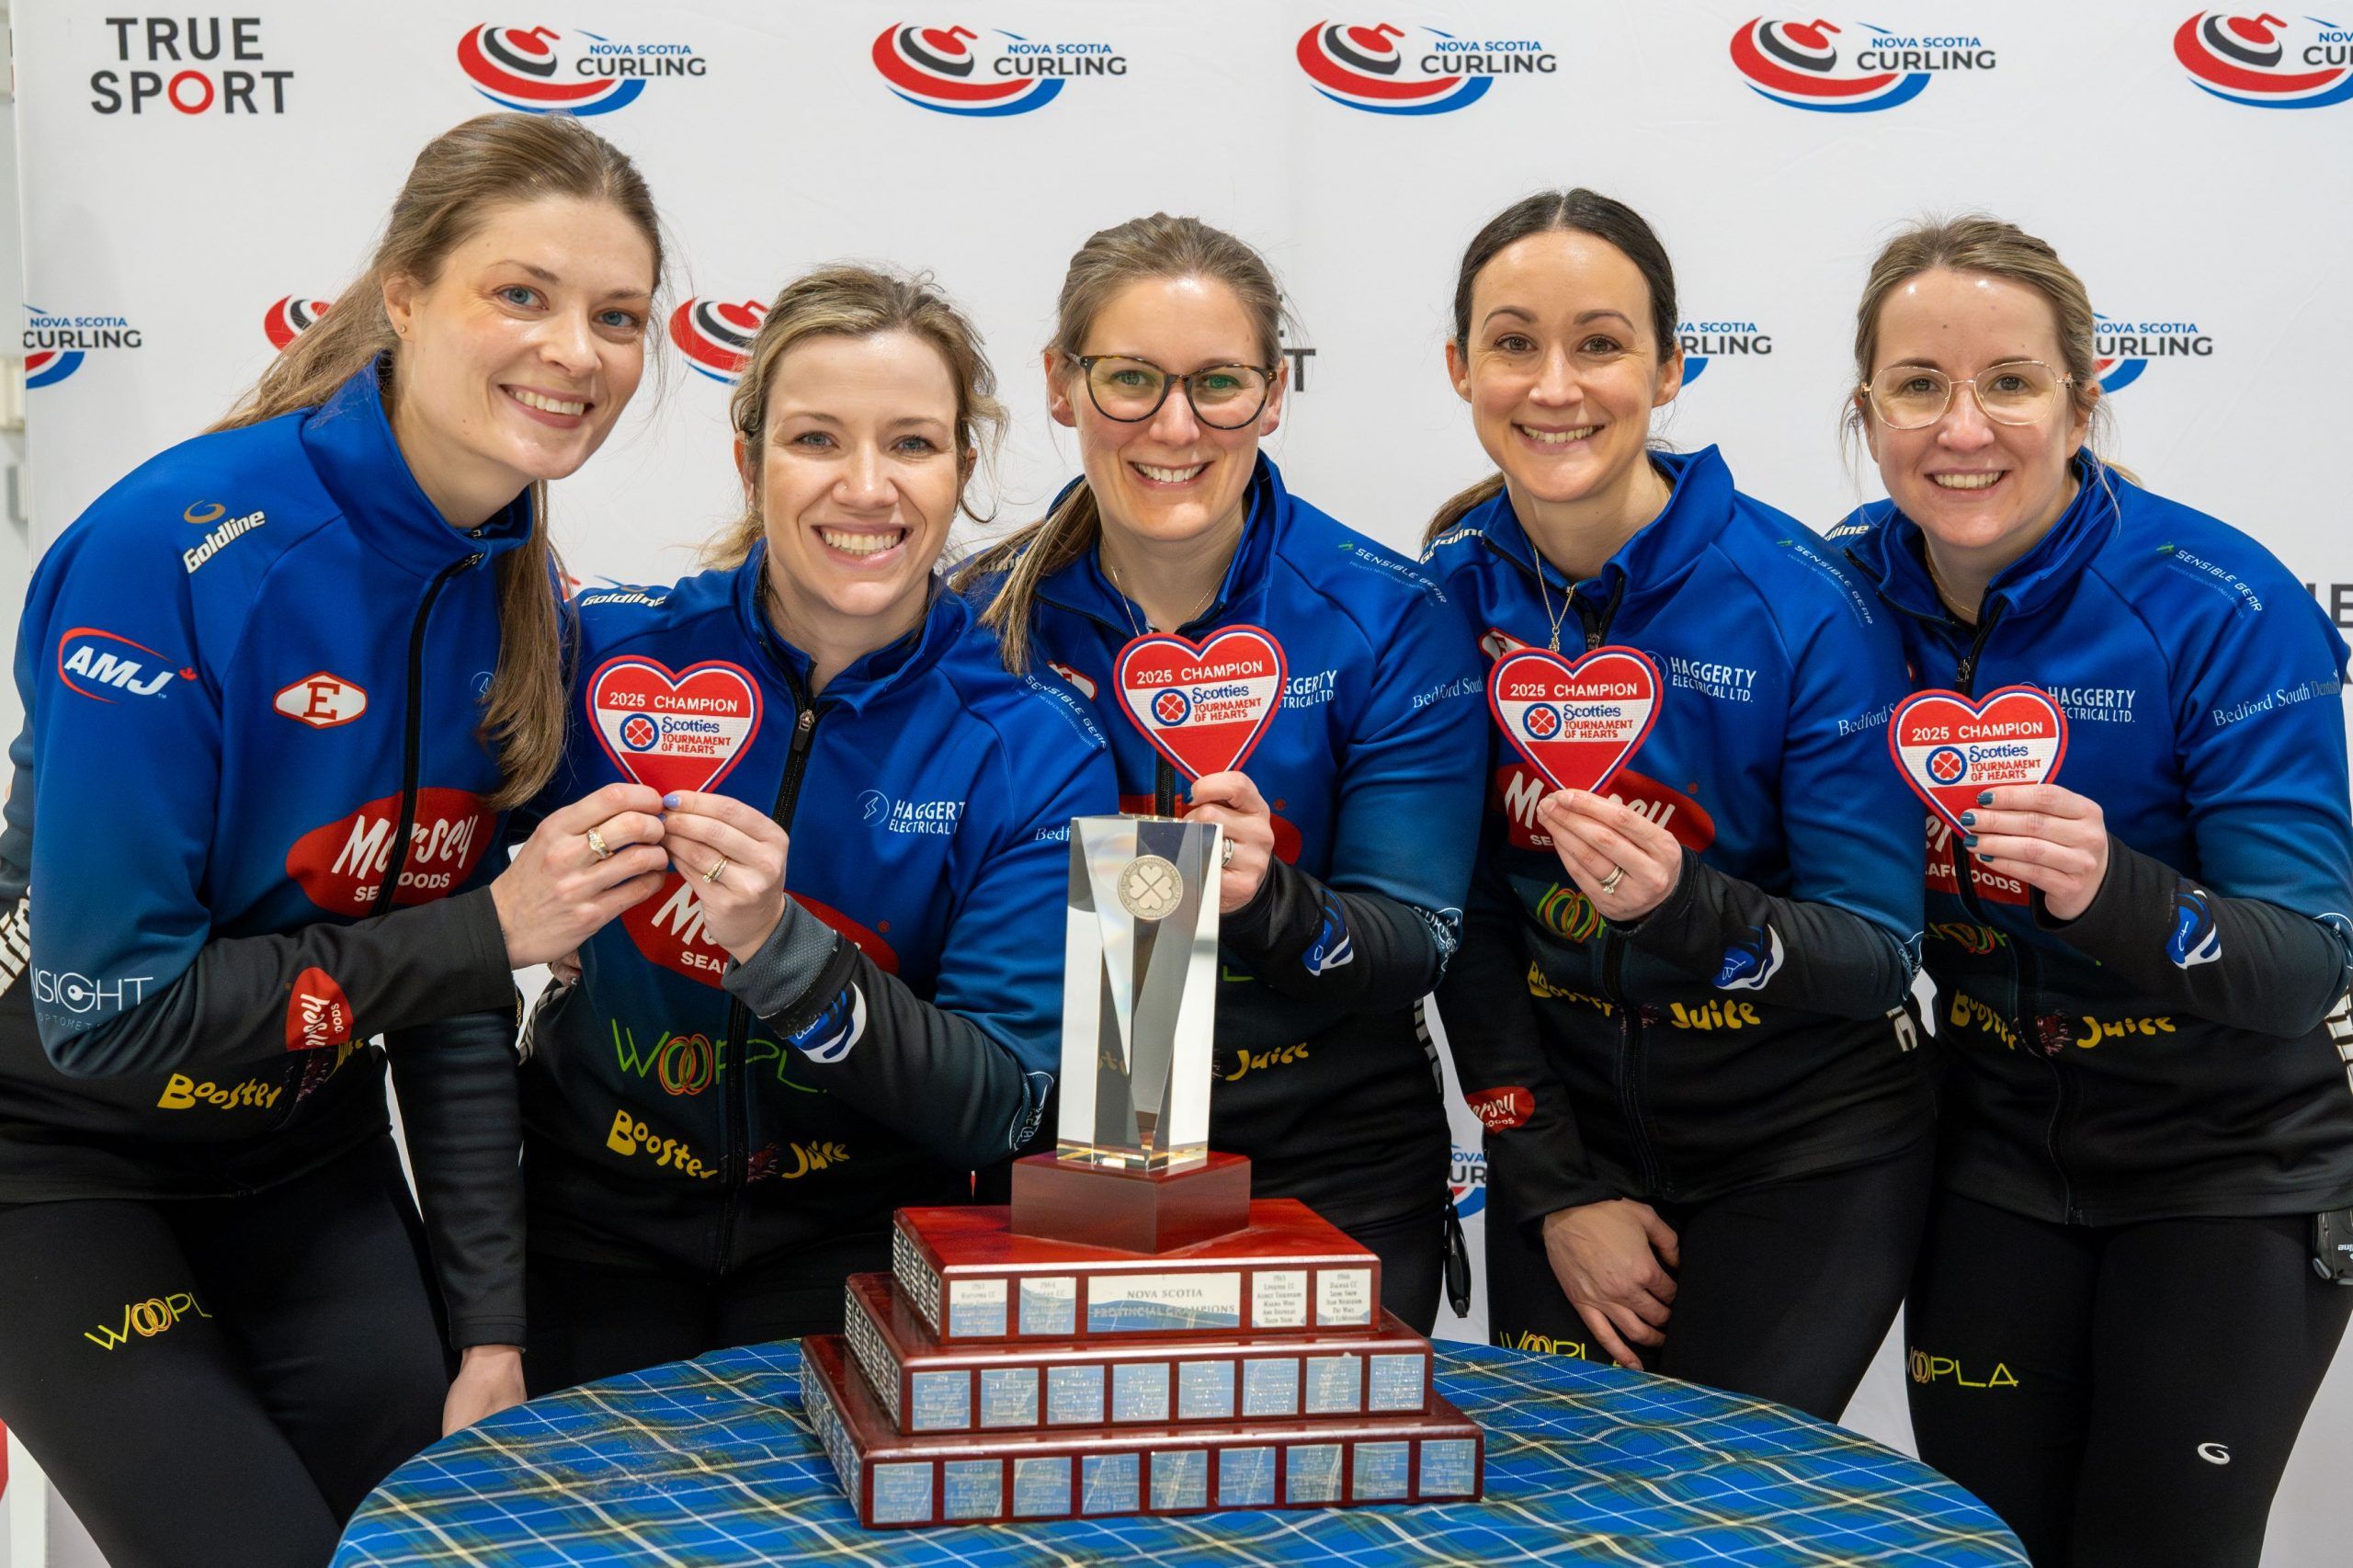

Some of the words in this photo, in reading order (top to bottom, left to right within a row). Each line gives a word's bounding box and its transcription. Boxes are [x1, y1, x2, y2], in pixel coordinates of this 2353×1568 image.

[107, 17, 264, 61] TRUE
[1436, 41, 1480, 52] NOVA
[1486, 41, 1542, 52] SCOTIA
[1872, 38, 1916, 48] NOVA
[1923, 38, 1982, 48] SCOTIA
[2319, 32, 2353, 42] NOV
[589, 44, 632, 54] NOVA
[637, 44, 692, 54] SCOTIA
[1008, 43, 1051, 54] NOVA
[1057, 43, 1112, 54] SCOTIA
[576, 57, 706, 77] CURLING
[994, 56, 1127, 76] CURLING
[1421, 54, 1557, 74] CURLING
[1857, 50, 1996, 70] CURLING
[90, 70, 294, 115] SPORT
[30, 317, 71, 327] NOVA
[75, 317, 128, 327] SCOTIA
[1699, 323, 1757, 333] SCOTIA
[2140, 323, 2199, 334] SCOTIA
[23, 330, 142, 348] CURLING
[1680, 335, 1772, 355] RLING
[2096, 336, 2213, 356] URLING
[184, 511, 266, 574] Goldline
[1355, 548, 1418, 580] SENSIBLE
[1419, 576, 1447, 603] GEAR
[1794, 545, 1853, 587] SENSIBLE
[1851, 590, 1873, 625] GEAR
[2176, 551, 2236, 582] SENSIBLE
[2234, 583, 2262, 611] GEAR
[63, 645, 175, 695] AMJ
[1137, 669, 1173, 685] 2025
[1181, 661, 1263, 681] CHAMPION
[1671, 656, 1757, 688] HAGGERTY
[1025, 676, 1085, 715] SENSIBLE
[1192, 684, 1249, 704] Scotties
[1413, 679, 1460, 708] Bedford
[1510, 684, 1546, 698] 2025
[1554, 683, 1637, 698] CHAMPION
[1672, 674, 1726, 699] ELECTRICAL
[1729, 687, 1754, 703] LTD.
[2048, 687, 2135, 709] HAGGERTY
[302, 682, 340, 720] E
[610, 692, 645, 707] 2025
[654, 695, 737, 712] CHAMPION
[1194, 699, 1261, 713] TOURNAMENT
[1281, 696, 1313, 709] TRICAL
[2213, 695, 2272, 726] Bedford
[2277, 683, 2310, 706] South
[1194, 711, 1208, 722] OF
[1210, 710, 1248, 722] HEARTS
[1563, 704, 1621, 722] Scotties
[1838, 705, 1887, 735] Bedford
[2113, 710, 2135, 722] LTD.
[662, 716, 720, 733] Scotties
[1564, 720, 1633, 730] TOURNAMENT
[1564, 729, 1577, 739] OF
[1580, 729, 1619, 739] HEARTS
[1912, 727, 1949, 742] 2025
[1959, 722, 2043, 740] CHAMPION
[662, 733, 731, 746] TOURNAMENT
[662, 743, 675, 752] OF
[677, 744, 715, 755] HEARTS
[1969, 745, 2029, 763] Scotties
[1971, 759, 2041, 773] TOURNAMENT
[1971, 772, 1984, 781] OF
[1987, 769, 2027, 781] HEARTS
[892, 800, 965, 820] HAGGERT
[889, 819, 950, 835] ELECTRICAL
[1035, 826, 1071, 841] Bedf
[354, 872, 450, 902] SEOODS
[29, 962, 153, 1013] NSIGHT
[1670, 1000, 1761, 1030] Juice
[2076, 1016, 2176, 1049] Juice
[613, 1019, 818, 1095] WOOPL
[1225, 1042, 1309, 1081] Juice
[157, 1073, 282, 1109] Booster
[607, 1109, 717, 1179] Booster
[1127, 1290, 1158, 1299] NOVA
[1162, 1289, 1203, 1298] SCOTIA
[1094, 1306, 1162, 1317] PROVINCIAL
[1166, 1304, 1235, 1317] CHAMPIONS
[85, 1292, 211, 1350] WOOPL
